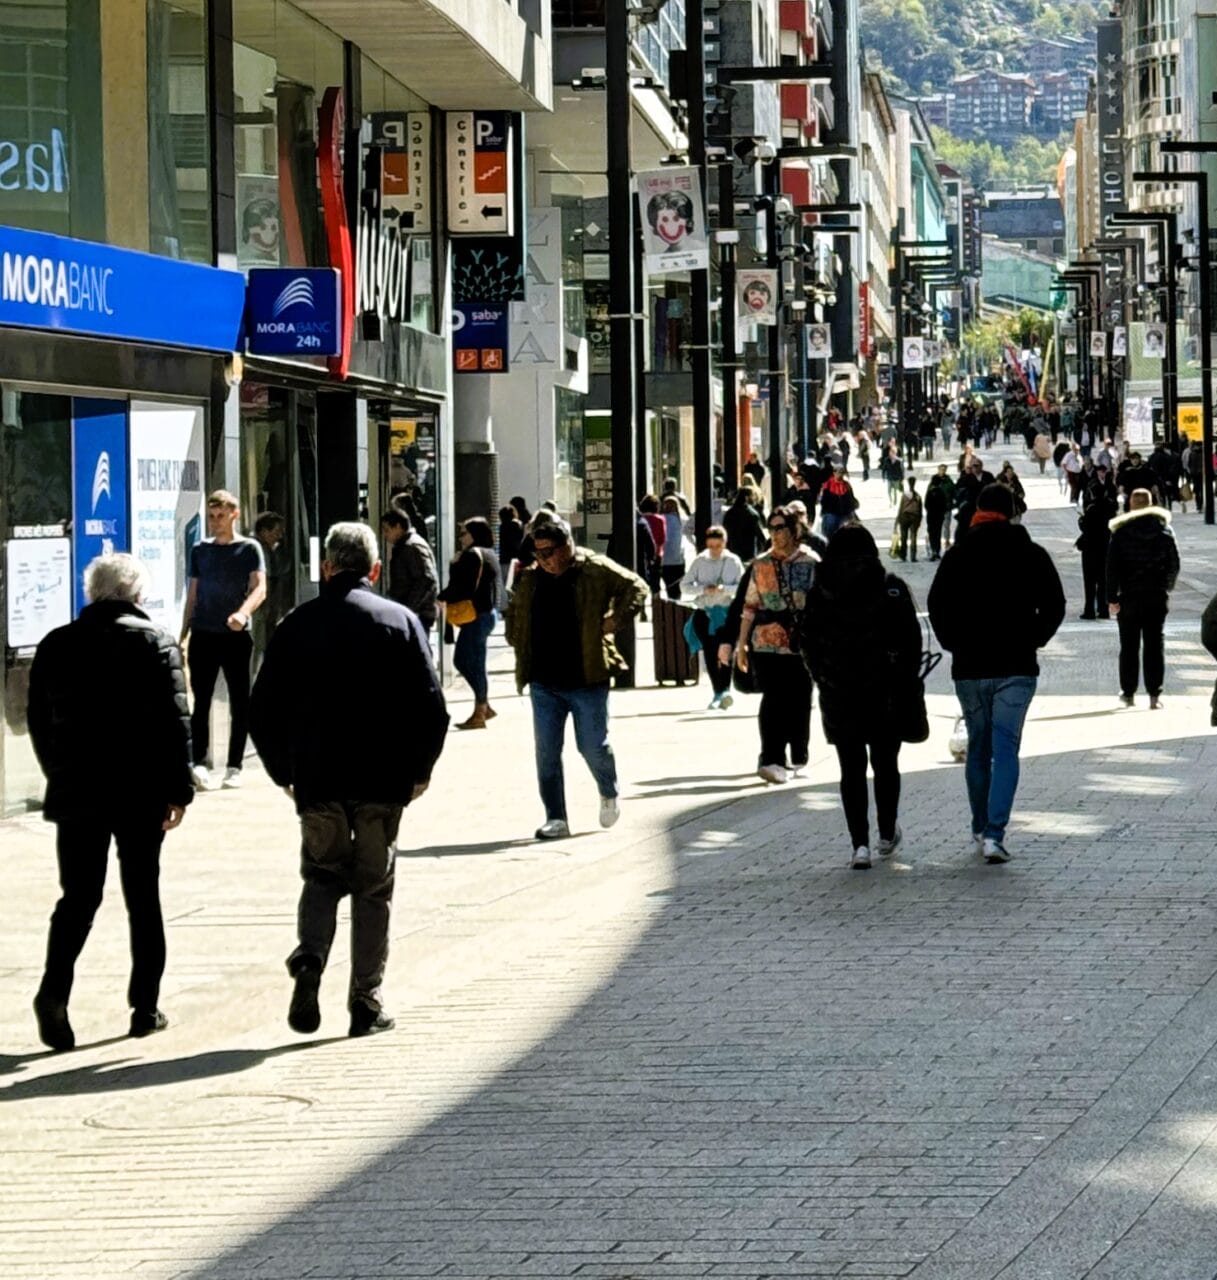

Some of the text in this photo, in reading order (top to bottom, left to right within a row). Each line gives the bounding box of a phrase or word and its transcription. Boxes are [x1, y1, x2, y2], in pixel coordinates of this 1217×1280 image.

[3, 252, 114, 315] MORABANC
[471, 309, 499, 321] saba
[257, 323, 330, 334] MORABANC
[296, 335, 321, 348] 24h
